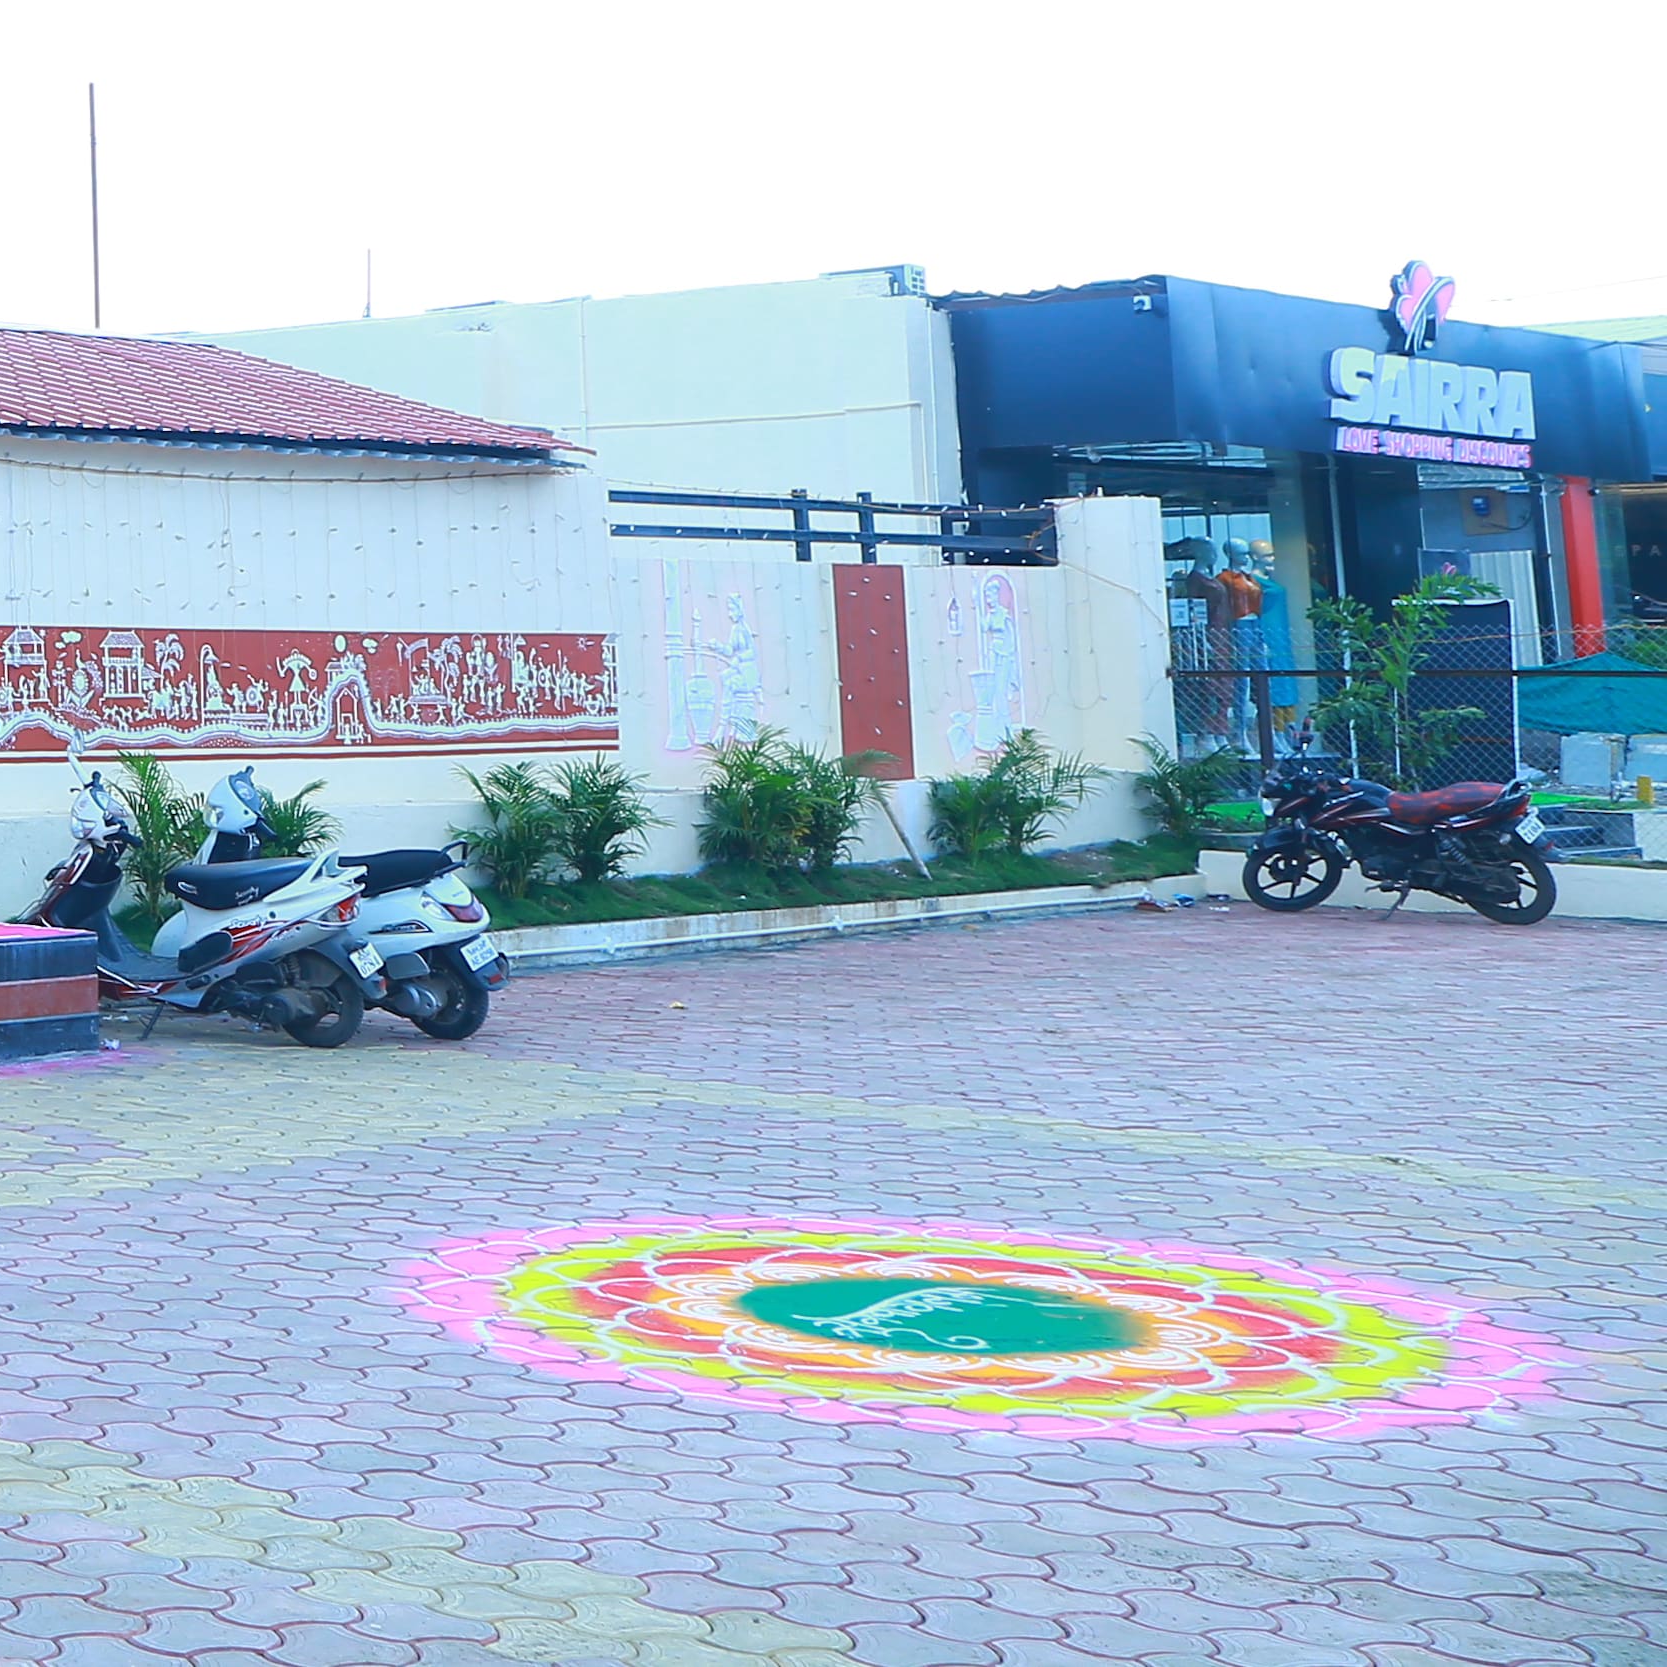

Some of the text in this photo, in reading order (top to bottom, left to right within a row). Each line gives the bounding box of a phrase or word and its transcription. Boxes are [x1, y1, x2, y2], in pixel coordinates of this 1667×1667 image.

[1330, 346, 1537, 440] SAIRRA
[1337, 426, 1533, 469] LOVE SHOPPING DISCOUNTS
